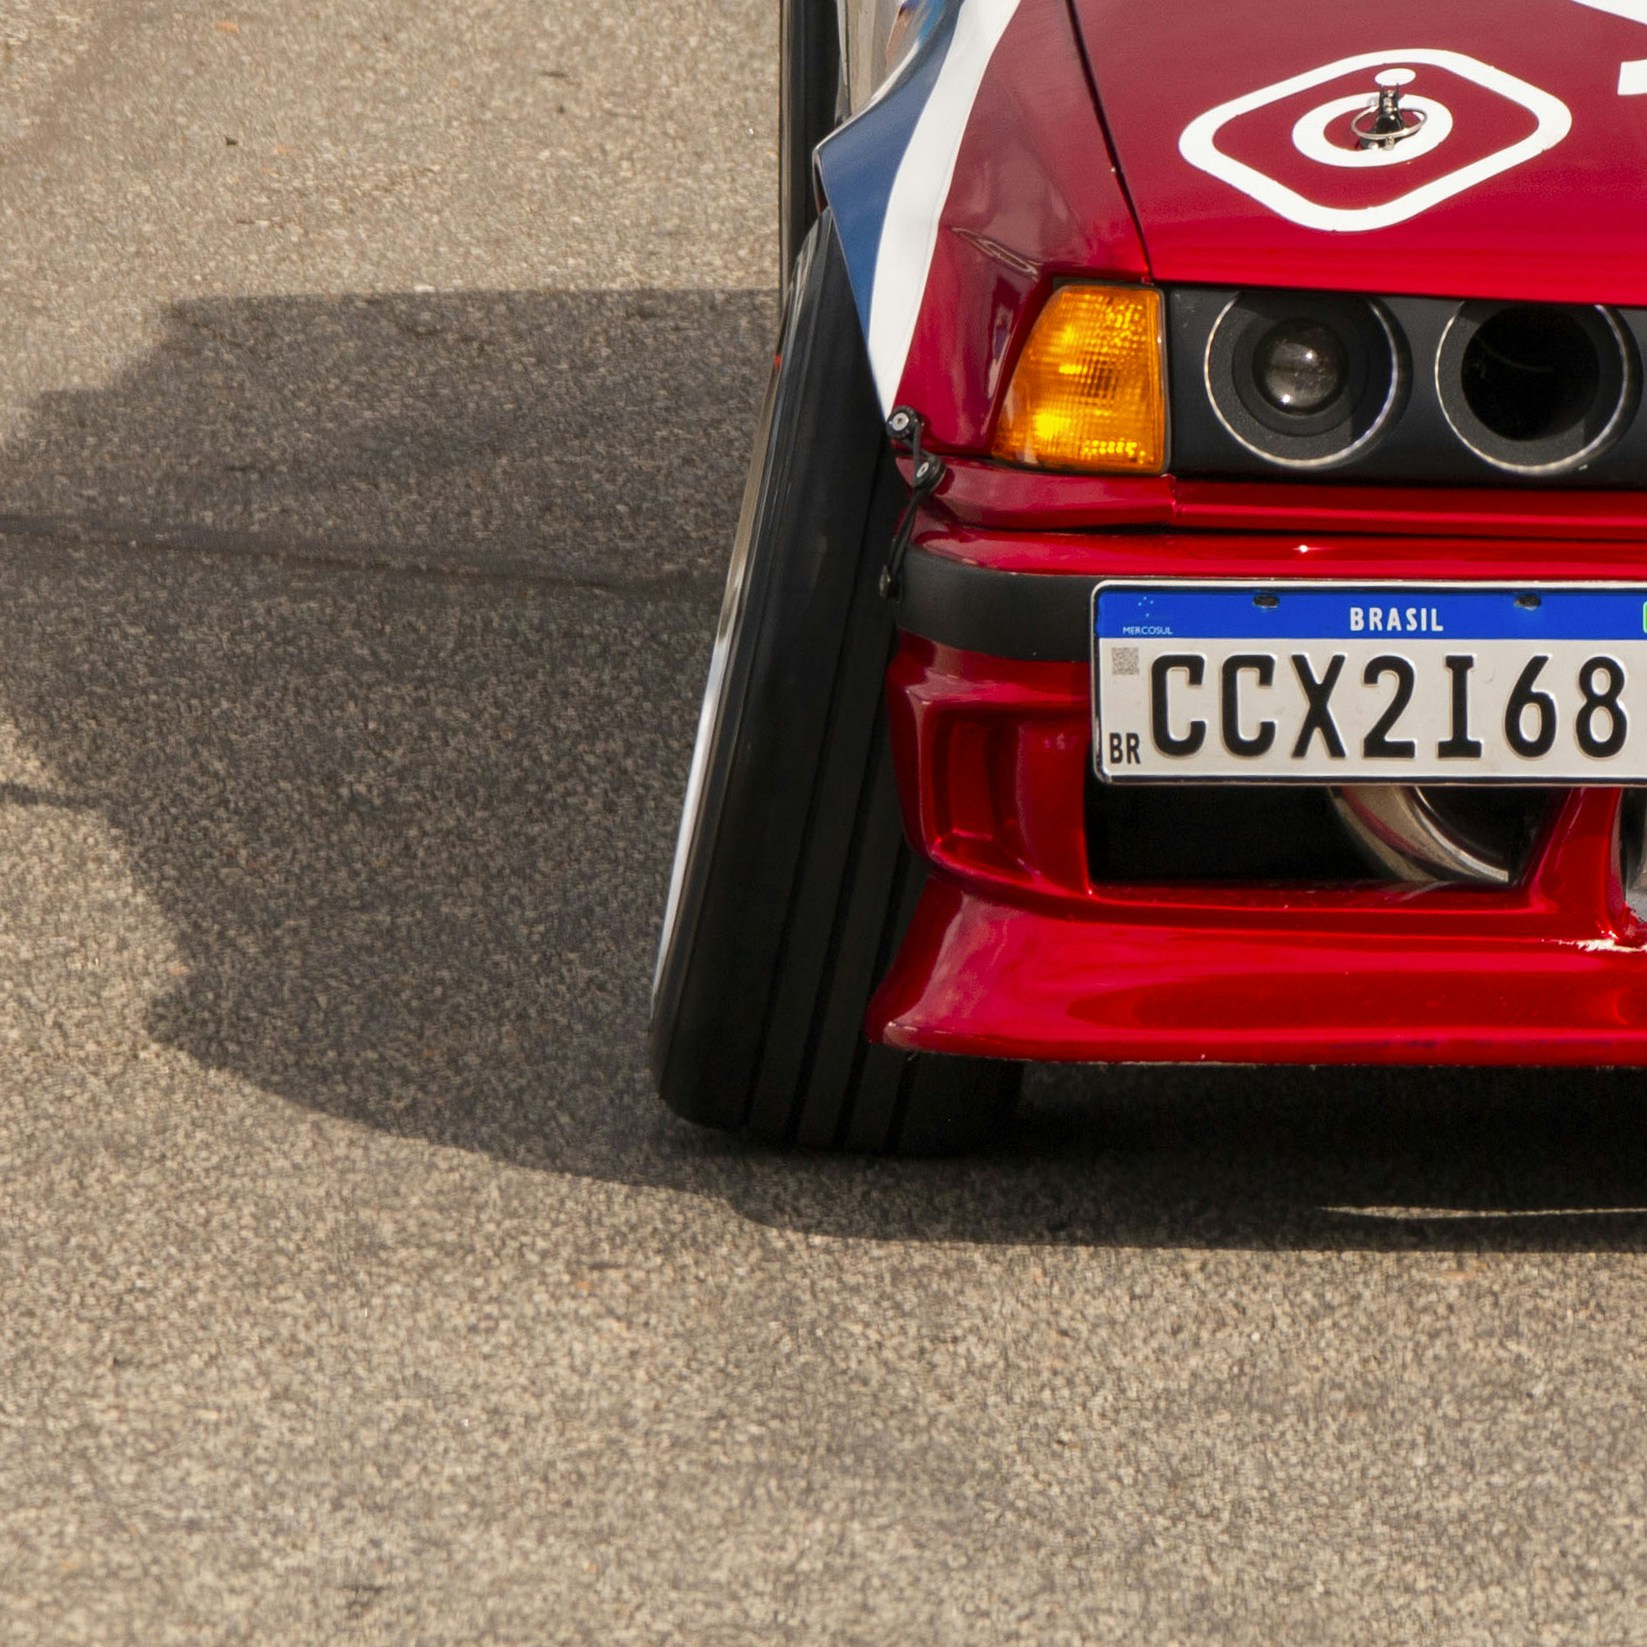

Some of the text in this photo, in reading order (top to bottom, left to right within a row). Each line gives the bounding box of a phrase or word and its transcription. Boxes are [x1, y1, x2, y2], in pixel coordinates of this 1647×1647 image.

[1122, 625, 1173, 636] MERCOSUL
[1349, 606, 1444, 632] BRASIL
[1151, 654, 1628, 759] CCX2I68
[1108, 731, 1141, 765] BR
